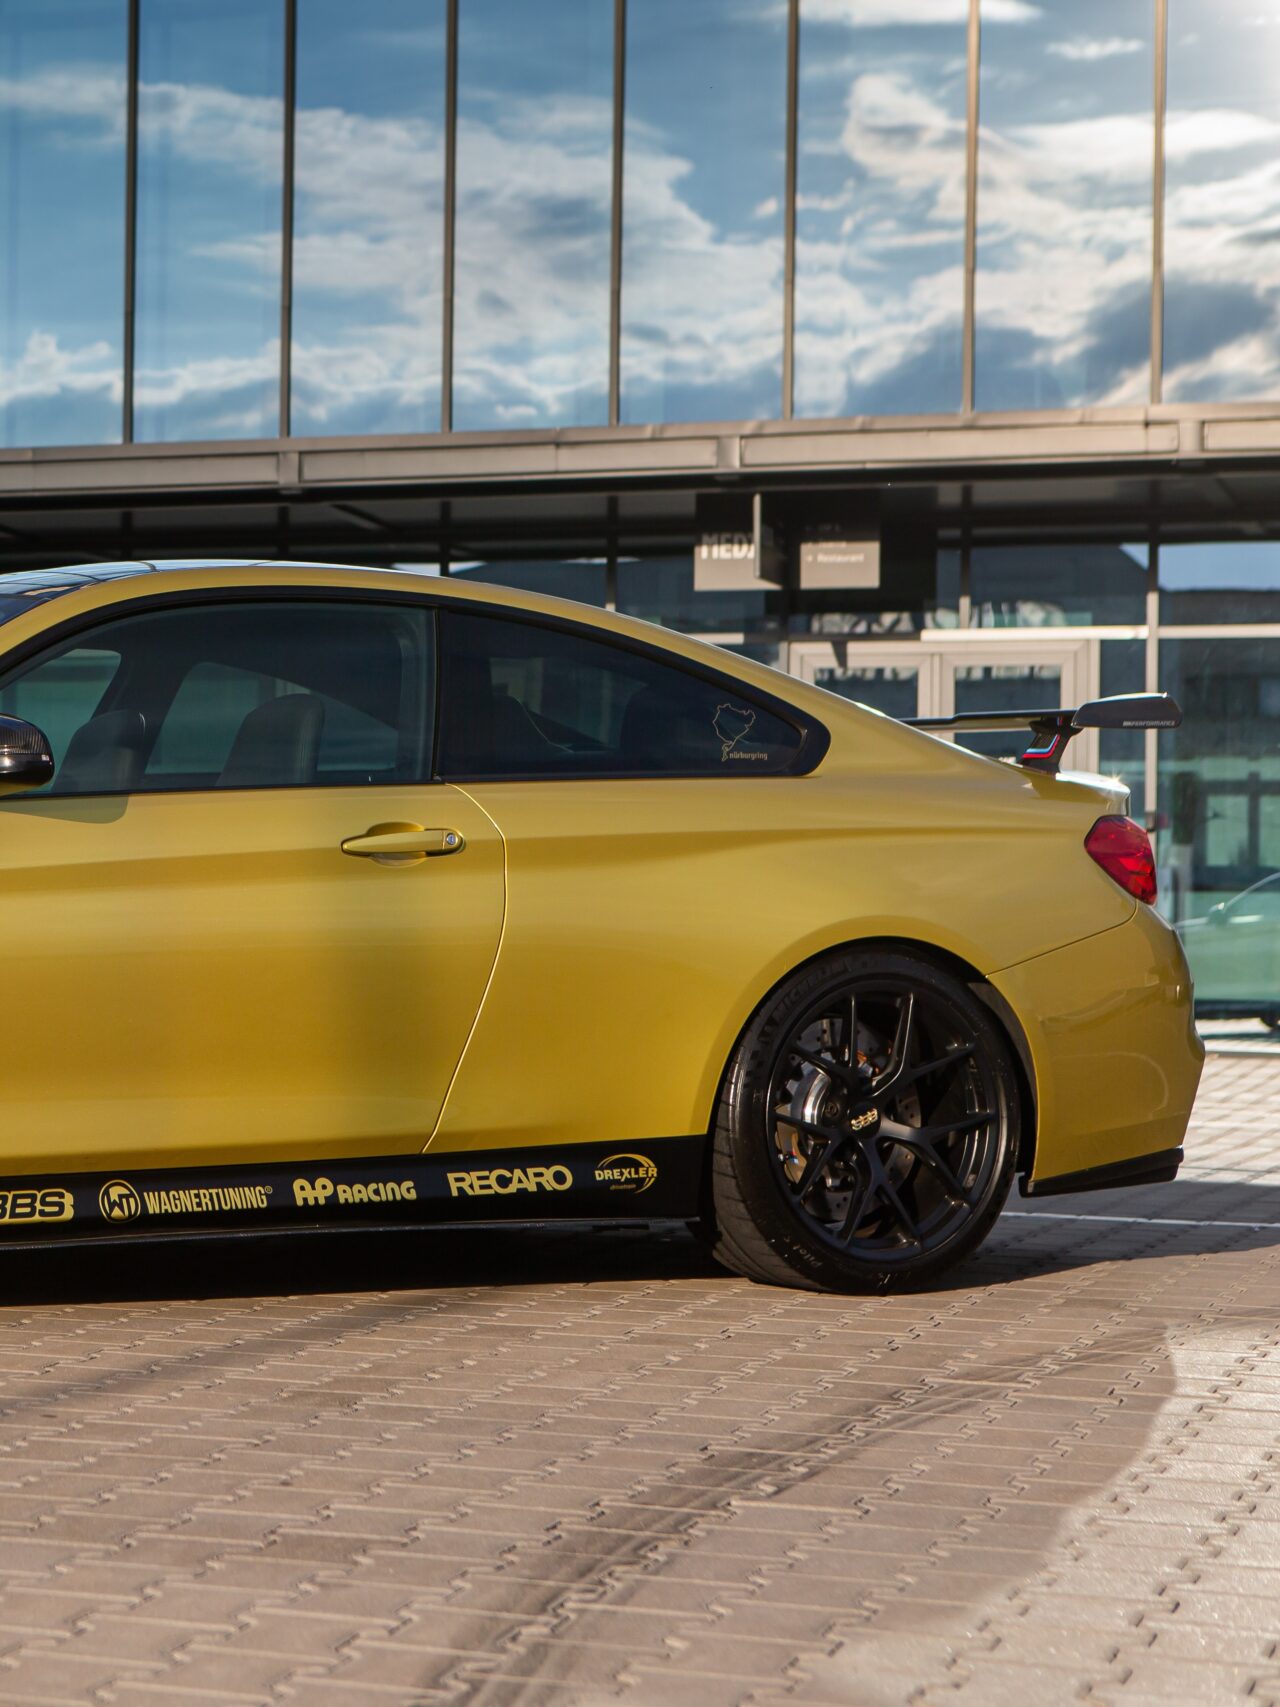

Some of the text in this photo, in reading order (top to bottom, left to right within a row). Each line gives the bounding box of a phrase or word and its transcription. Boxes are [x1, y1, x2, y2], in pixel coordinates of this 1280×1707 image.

[729, 751, 768, 761] nürburgring
[851, 1108, 878, 1130] BBS
[447, 1165, 574, 1197] RECARO
[594, 1167, 658, 1182] DREXLER
[337, 1181, 417, 1204] RACING
